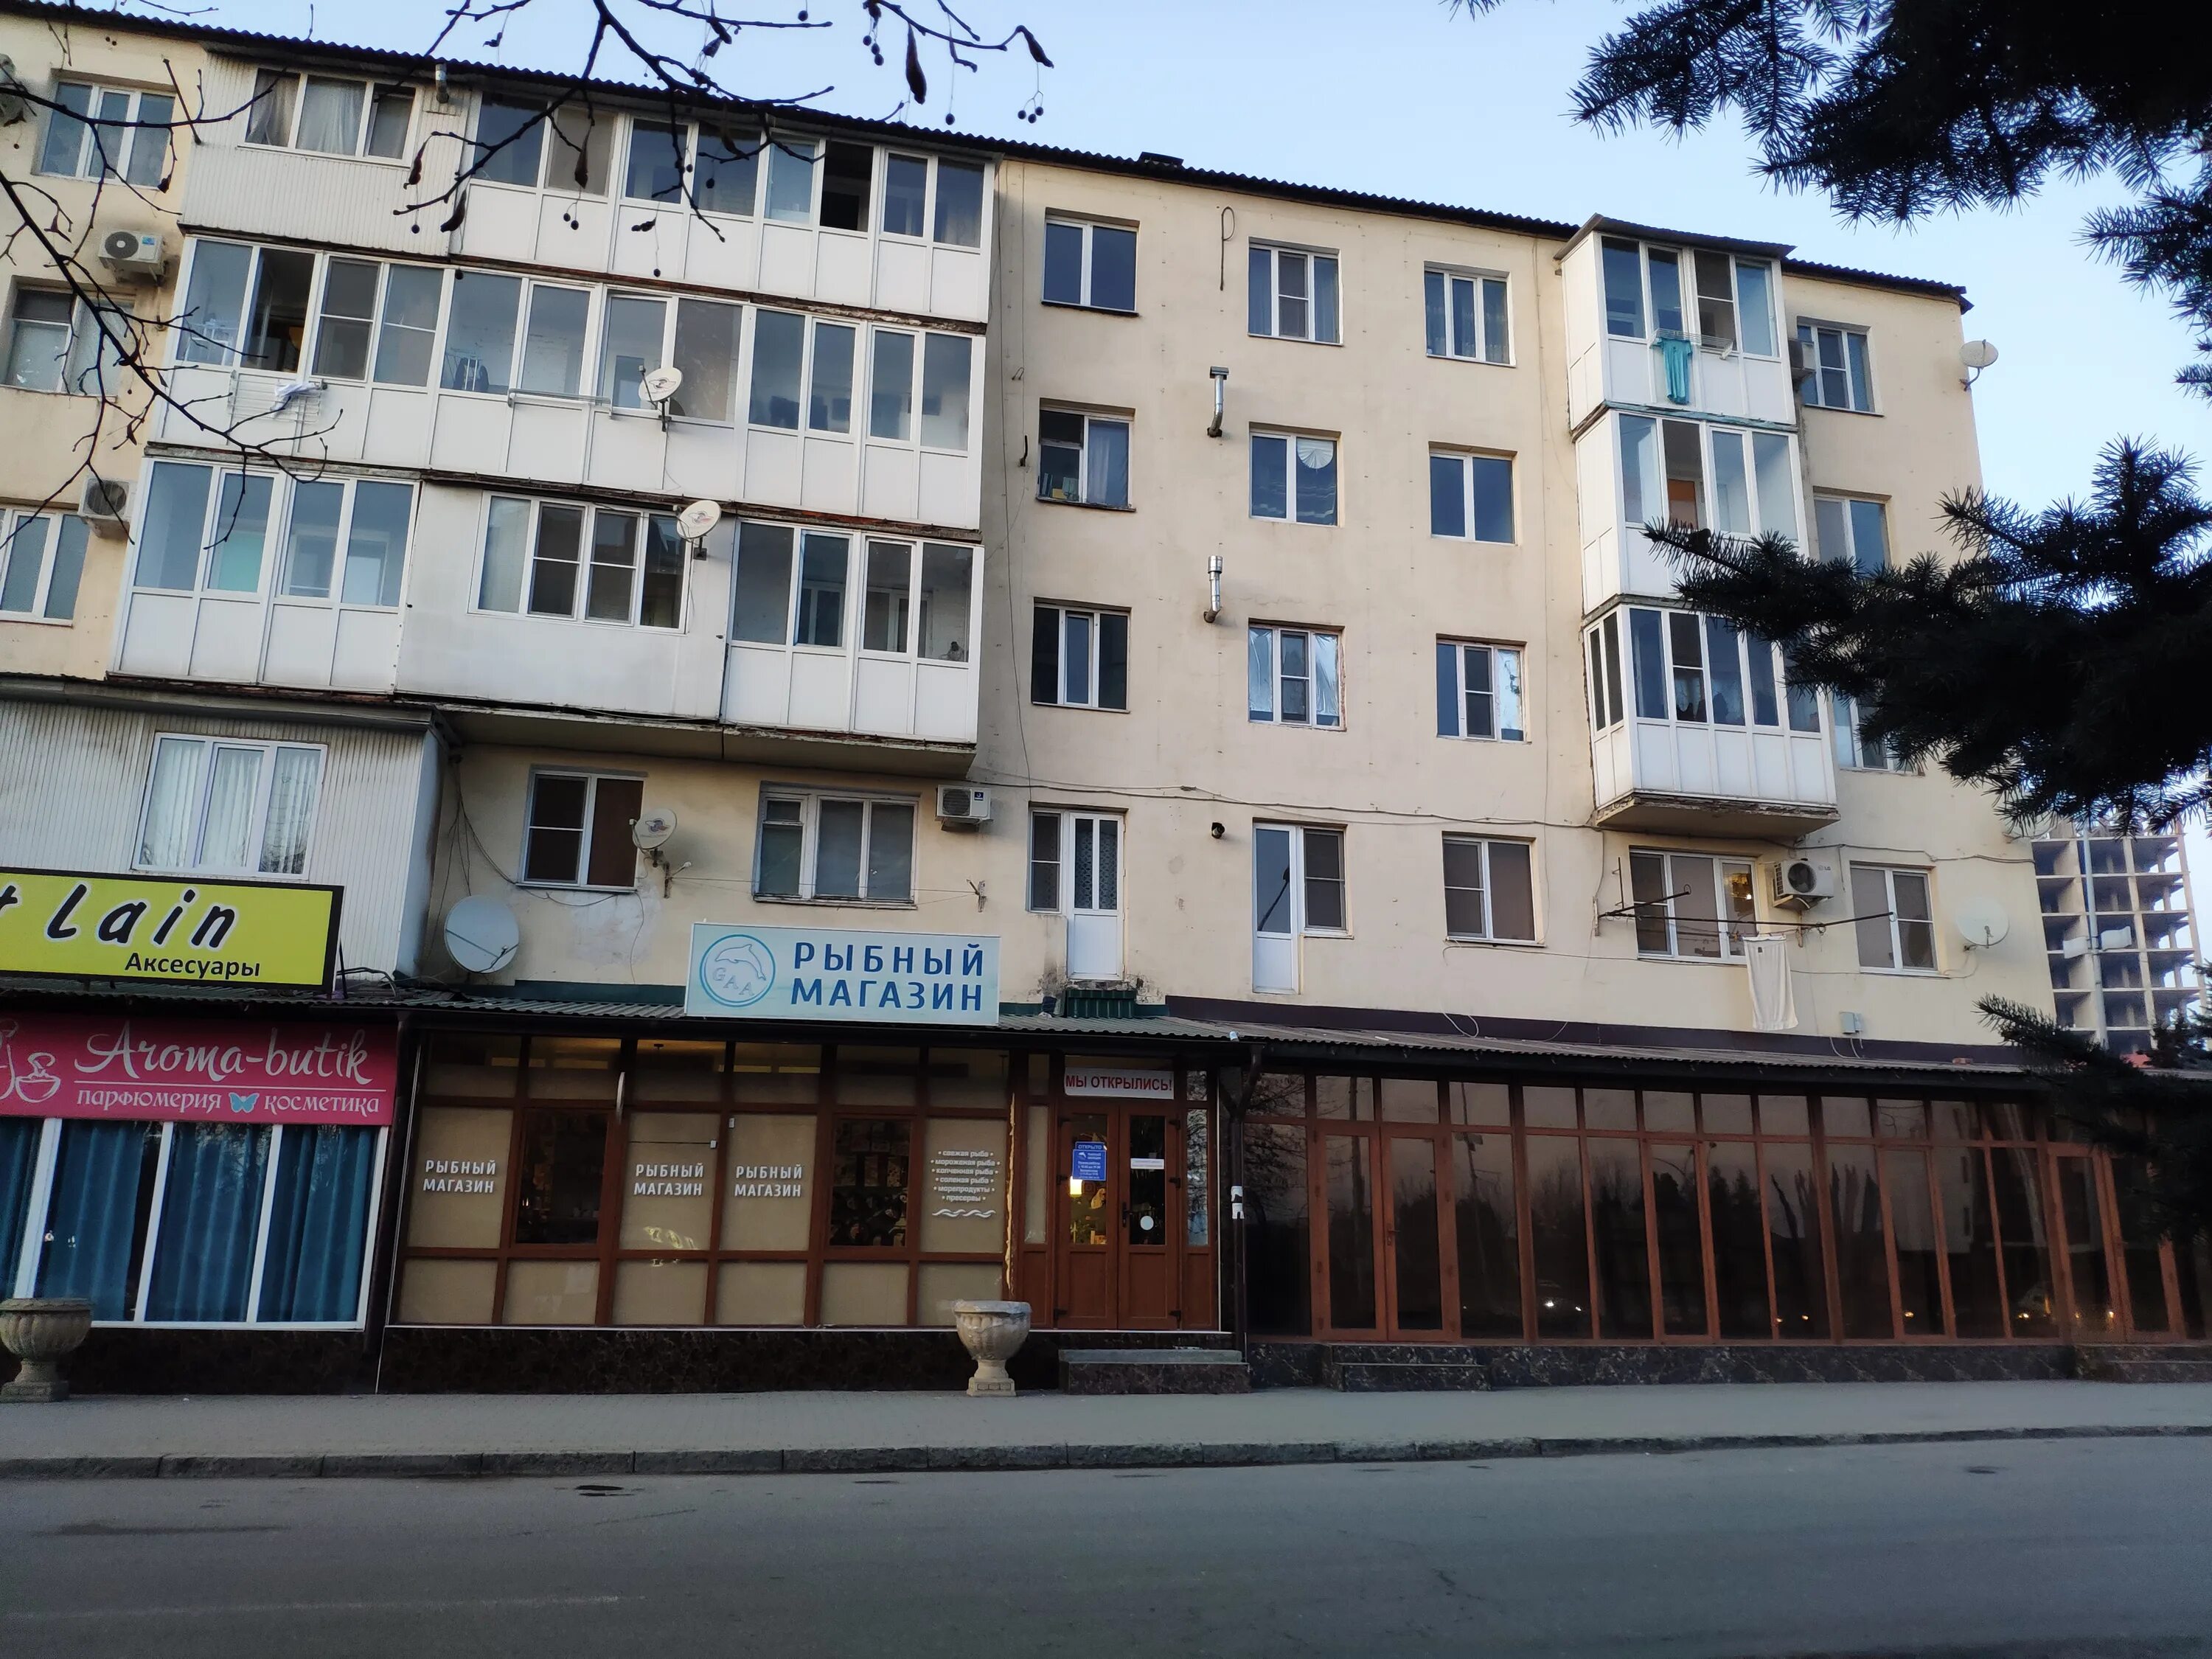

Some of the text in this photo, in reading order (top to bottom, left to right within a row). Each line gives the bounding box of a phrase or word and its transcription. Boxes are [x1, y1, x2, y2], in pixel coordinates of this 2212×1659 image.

[124, 953, 260, 980] Аксесуары
[794, 942, 984, 977] РЫБНЫЙ
[790, 978, 982, 1011] МАГАЗИН
[74, 1020, 373, 1085] Aroma-butik
[1065, 1075, 1172, 1091] МЫ ОТКРЫЛИСЬ!
[77, 1088, 380, 1117] парфюмерия косметика
[425, 1159, 496, 1175] РЫБНЫЙ
[635, 1162, 704, 1178] РЫБНЫЙ
[735, 1164, 803, 1180] РЫБНЫЙ
[422, 1179, 495, 1194] МАГАЗИН
[633, 1182, 703, 1197] МАГАЗИН
[734, 1183, 802, 1197] МАГАЗИН
